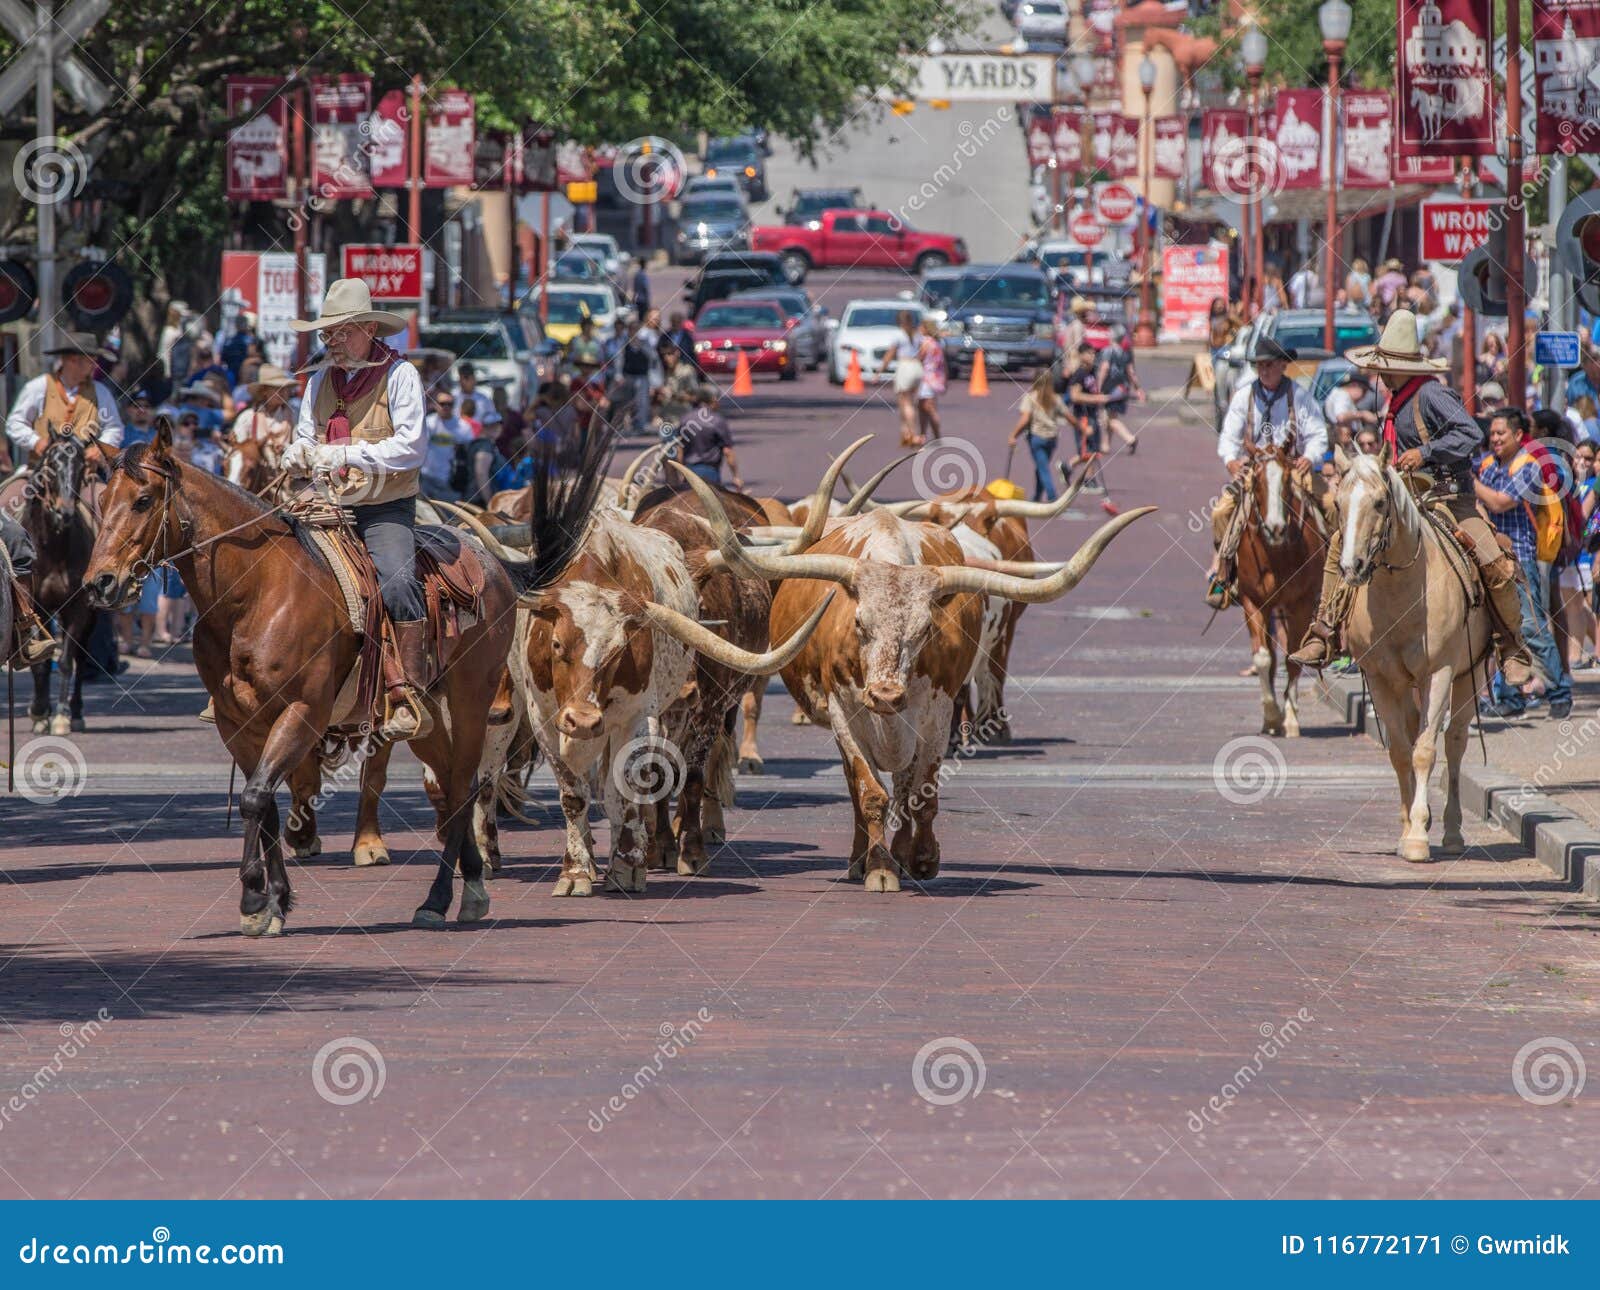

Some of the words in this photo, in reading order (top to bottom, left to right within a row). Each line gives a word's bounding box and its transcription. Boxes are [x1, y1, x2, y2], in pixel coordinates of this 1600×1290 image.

[942, 60, 1037, 89] YARDS
[1432, 210, 1490, 231] WRON
[351, 254, 416, 272] WRONG
[263, 271, 320, 294] TOUS
